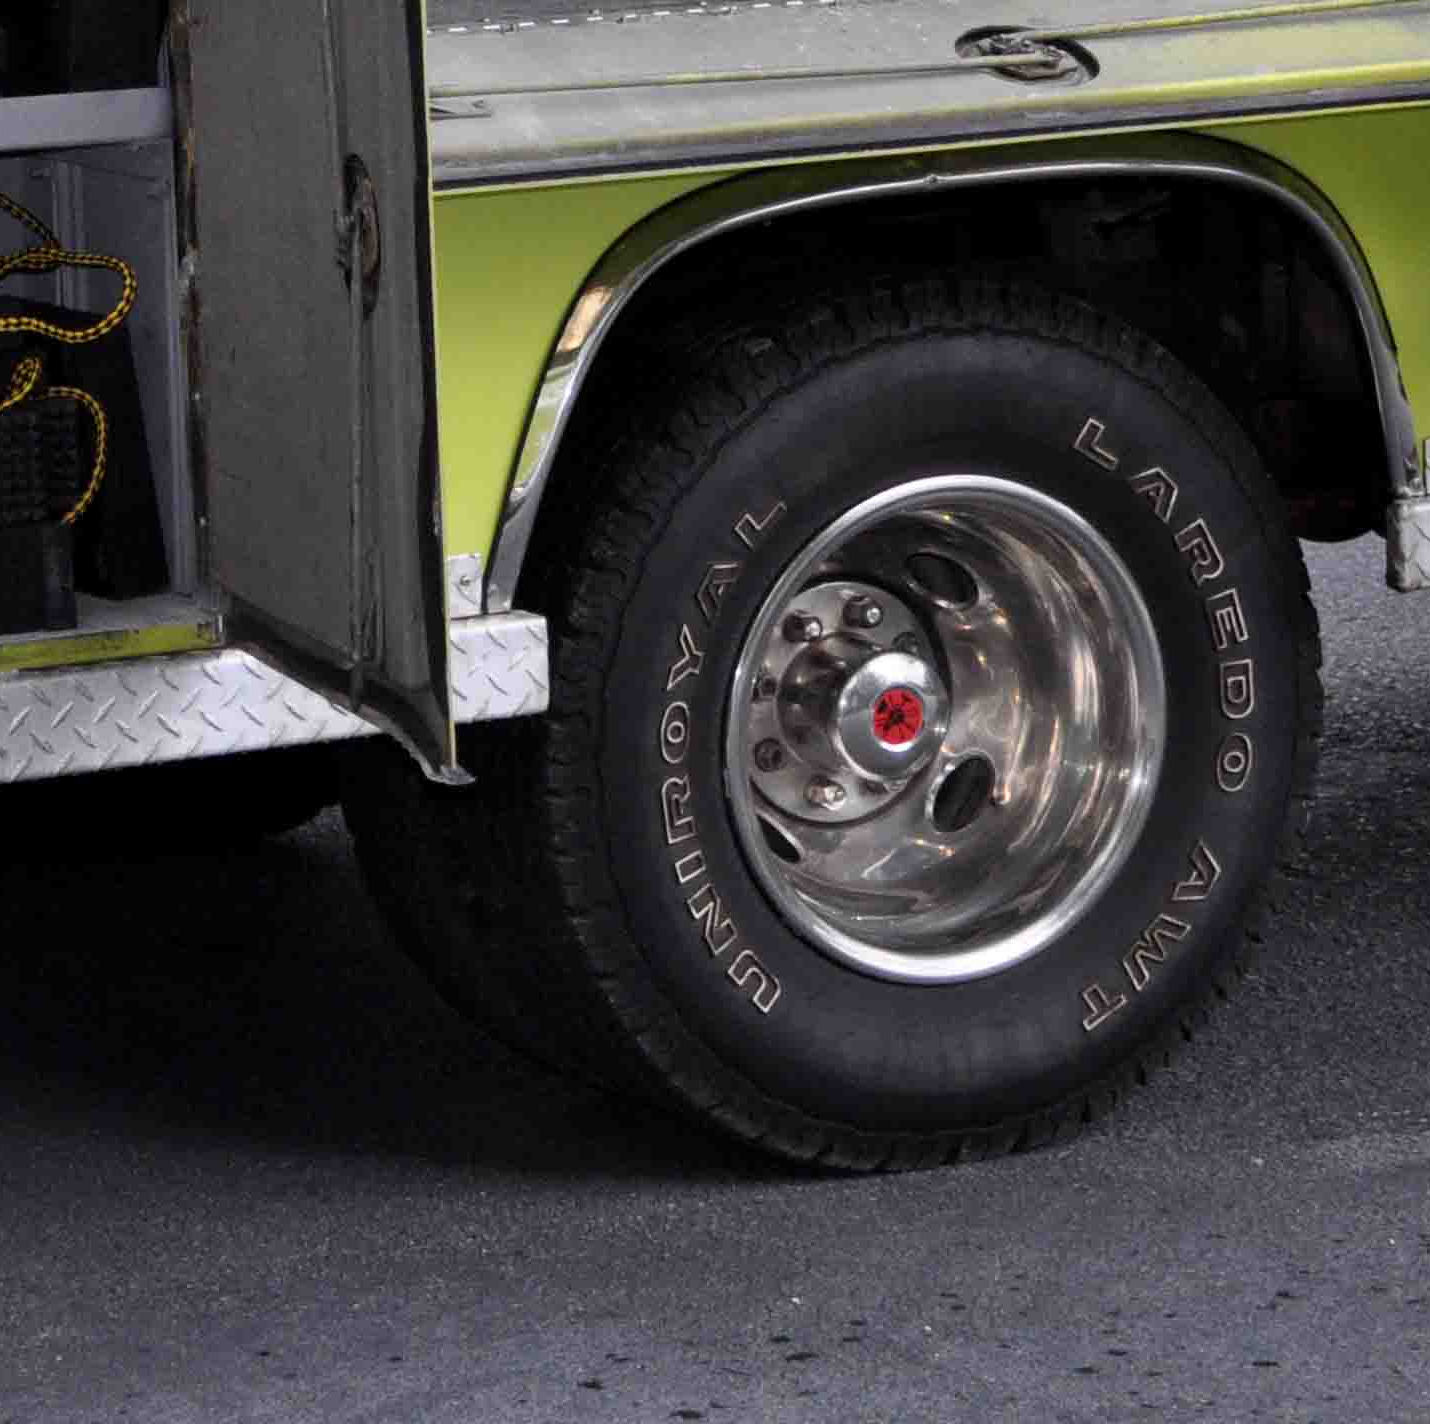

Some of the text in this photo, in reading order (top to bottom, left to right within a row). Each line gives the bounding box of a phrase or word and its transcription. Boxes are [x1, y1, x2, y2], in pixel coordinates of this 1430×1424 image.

[659, 499, 787, 1014] UNIROYAL
[1073, 417, 1255, 1032] LAREDO AWT
